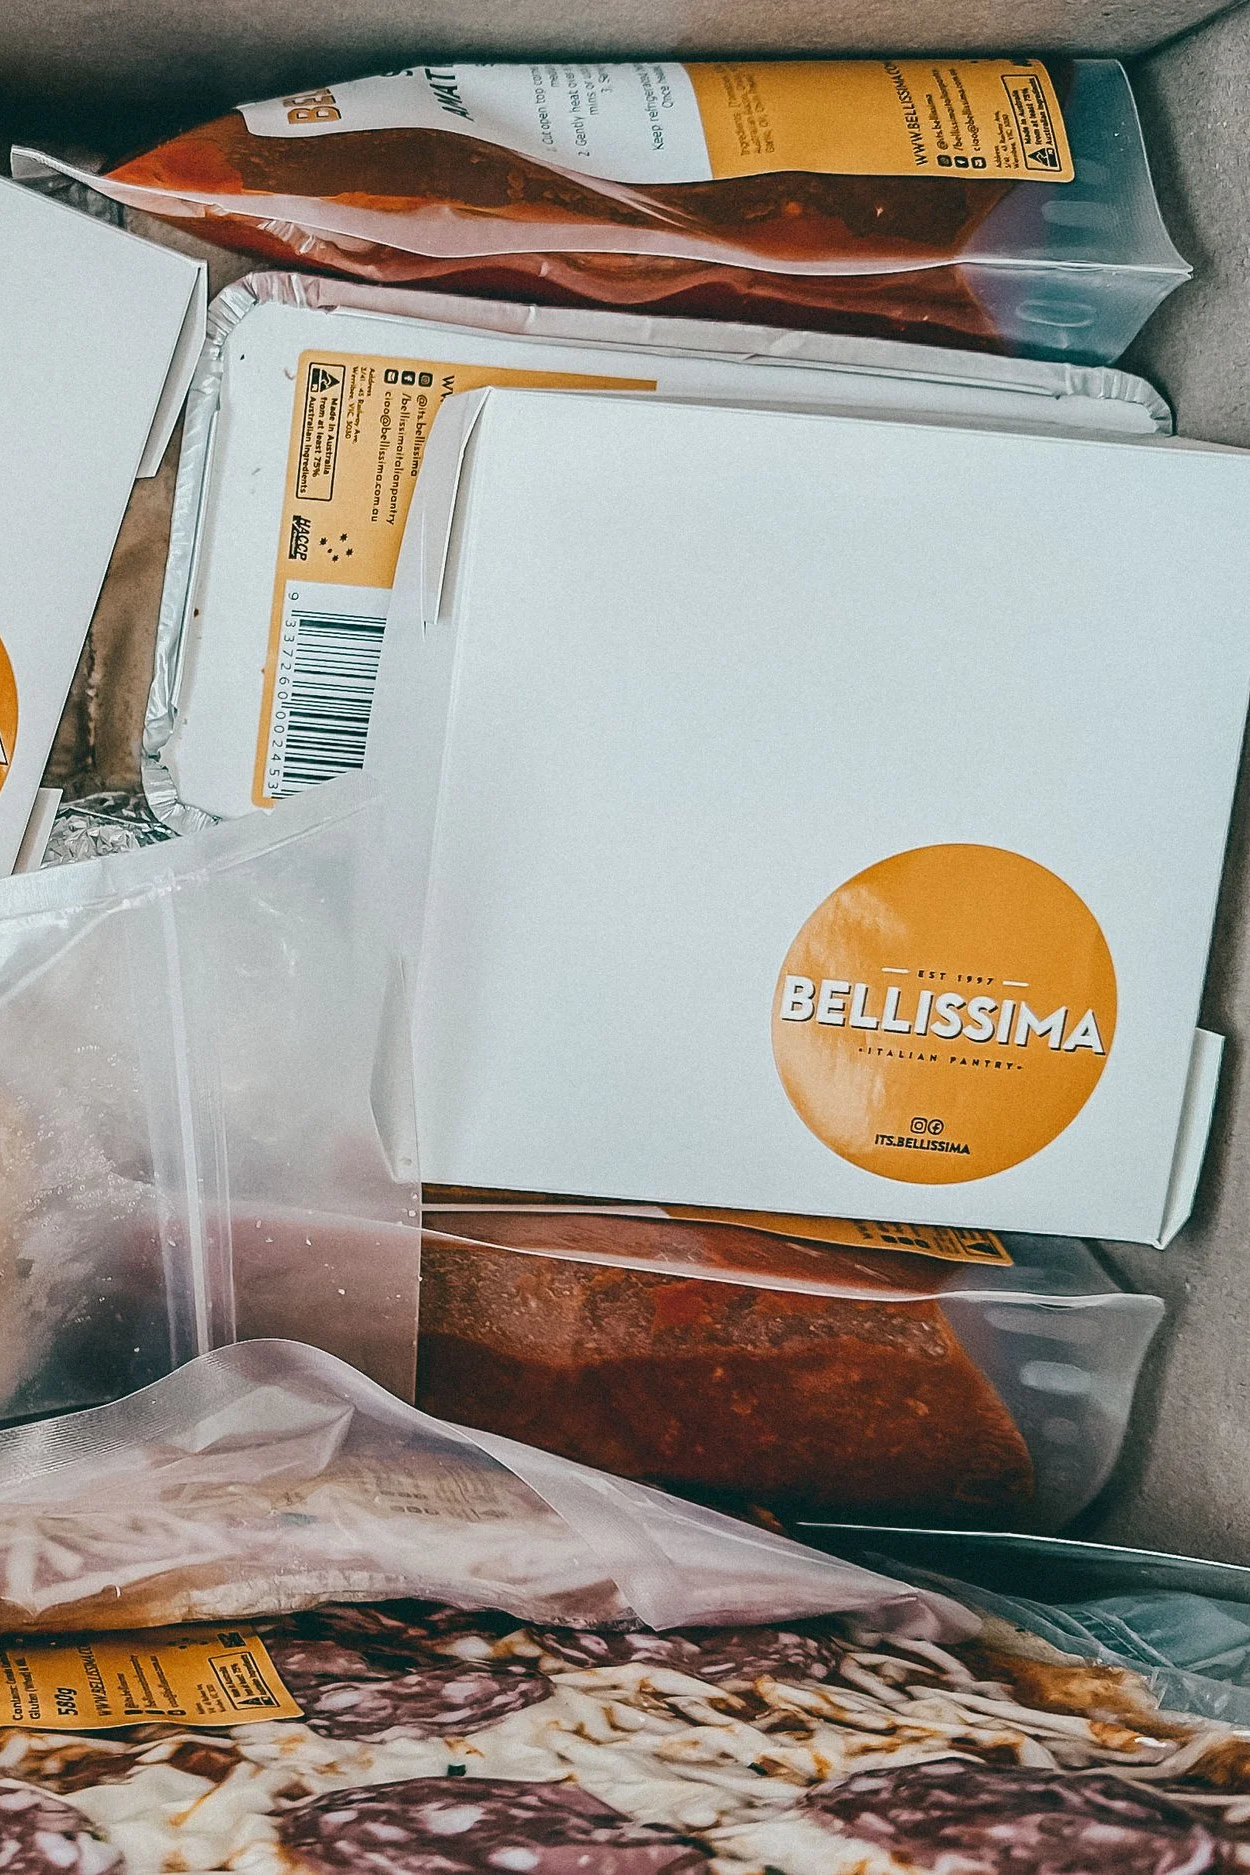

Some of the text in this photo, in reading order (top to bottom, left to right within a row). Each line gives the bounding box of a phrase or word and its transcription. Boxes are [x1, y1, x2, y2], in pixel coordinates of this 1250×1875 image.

[424, 65, 474, 122] AMAT
[568, 89, 581, 113] heat
[583, 92, 599, 115] mins
[658, 85, 674, 109] Once
[1011, 89, 1026, 118] Australia
[533, 88, 554, 145] Cut open top
[571, 115, 588, 146] Gently
[1021, 87, 1043, 146] from at least 75%
[1038, 110, 1054, 147] Australian
[648, 124, 665, 151] Keep
[1021, 126, 1032, 145] Made
[305, 395, 317, 443] Australian
[318, 396, 328, 417] from
[328, 397, 339, 422] Made
[354, 399, 363, 427] Railway
[314, 431, 325, 454] least
[410, 394, 428, 477] @its.bellissima
[312, 456, 322, 478] 75%
[322, 434, 335, 475] Australia
[371, 391, 394, 522] ciao@bellissima.com.au
[386, 392, 412, 526] /bellissimaitalianpantry
[297, 517, 312, 562] HACCP
[288, 592, 299, 601] 9
[917, 969, 995, 985] EST 1997
[779, 973, 1106, 1055] BELLISSIMA
[867, 1047, 1014, 1070] ITALIAN PANTRY
[873, 1133, 970, 1155] ITS.BELLISSIMA
[54, 1687, 78, 1716] 580g
